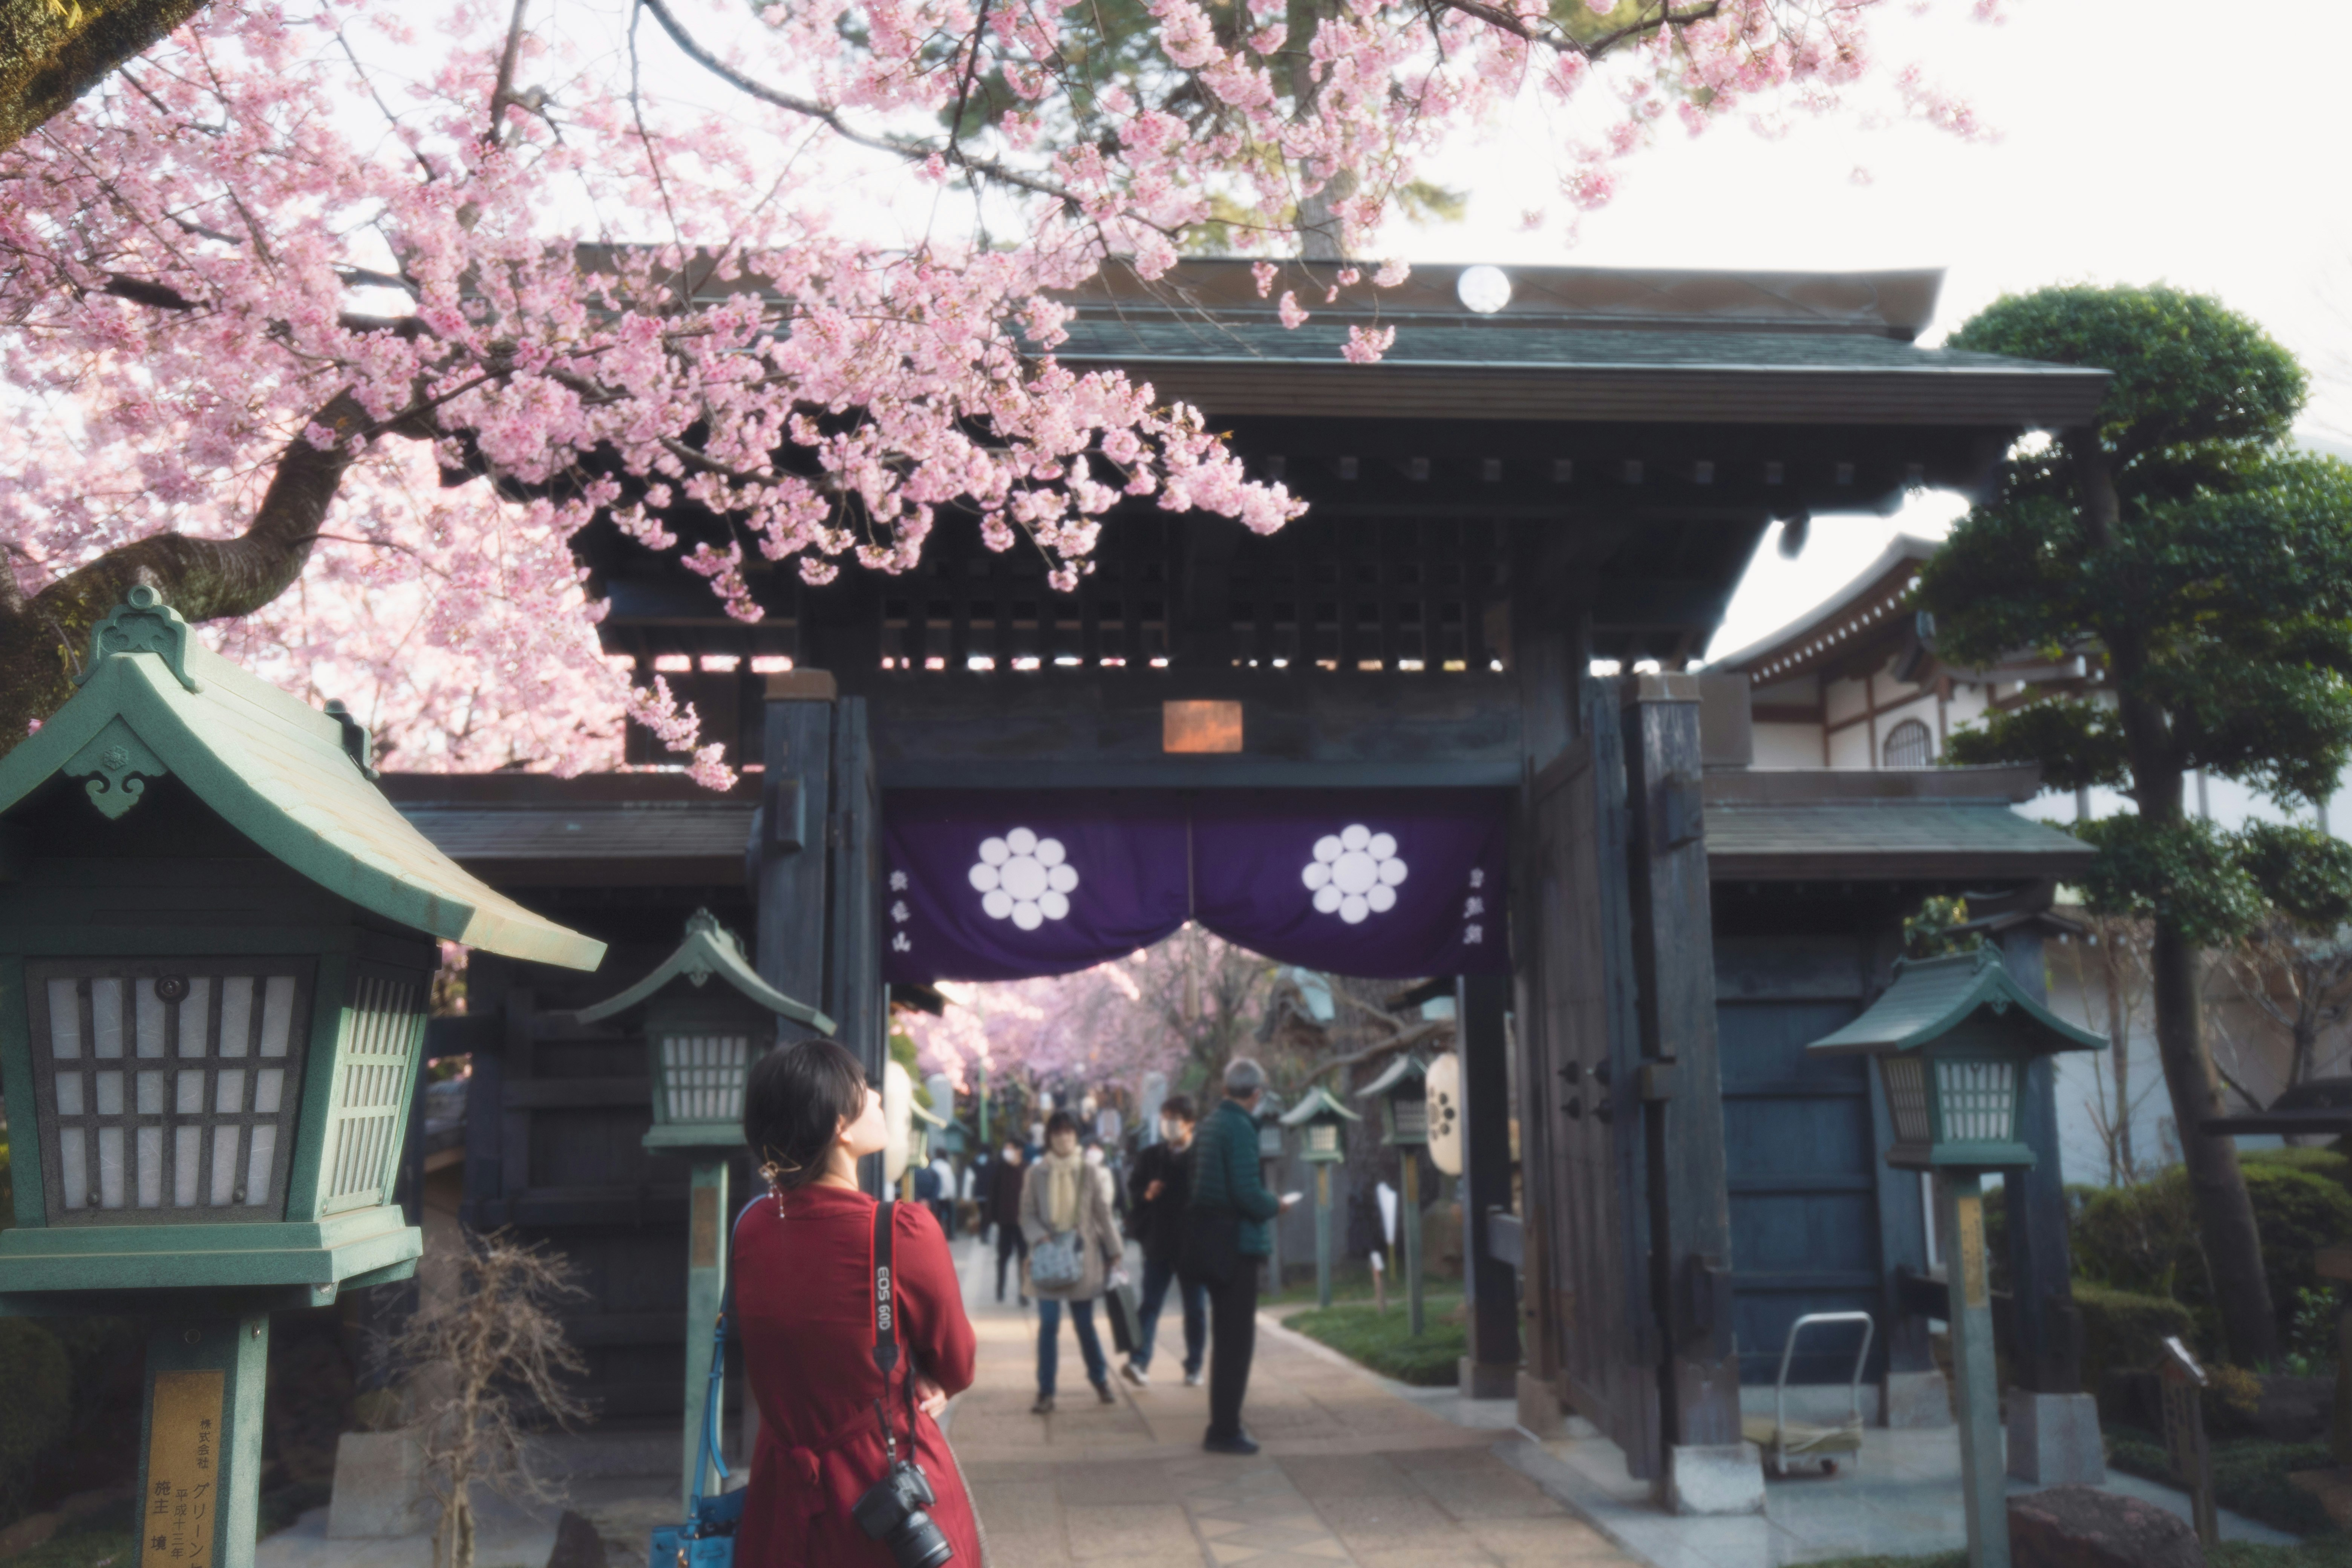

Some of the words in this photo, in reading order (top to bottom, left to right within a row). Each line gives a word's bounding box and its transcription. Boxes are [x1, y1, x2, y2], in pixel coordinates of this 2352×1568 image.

[878, 1267, 890, 1300] EOS
[878, 1305, 891, 1330] 60D
[197, 1418, 212, 1468] 株式会社
[153, 1481, 171, 1514] 施主
[171, 1489, 188, 1560] 平成十三年
